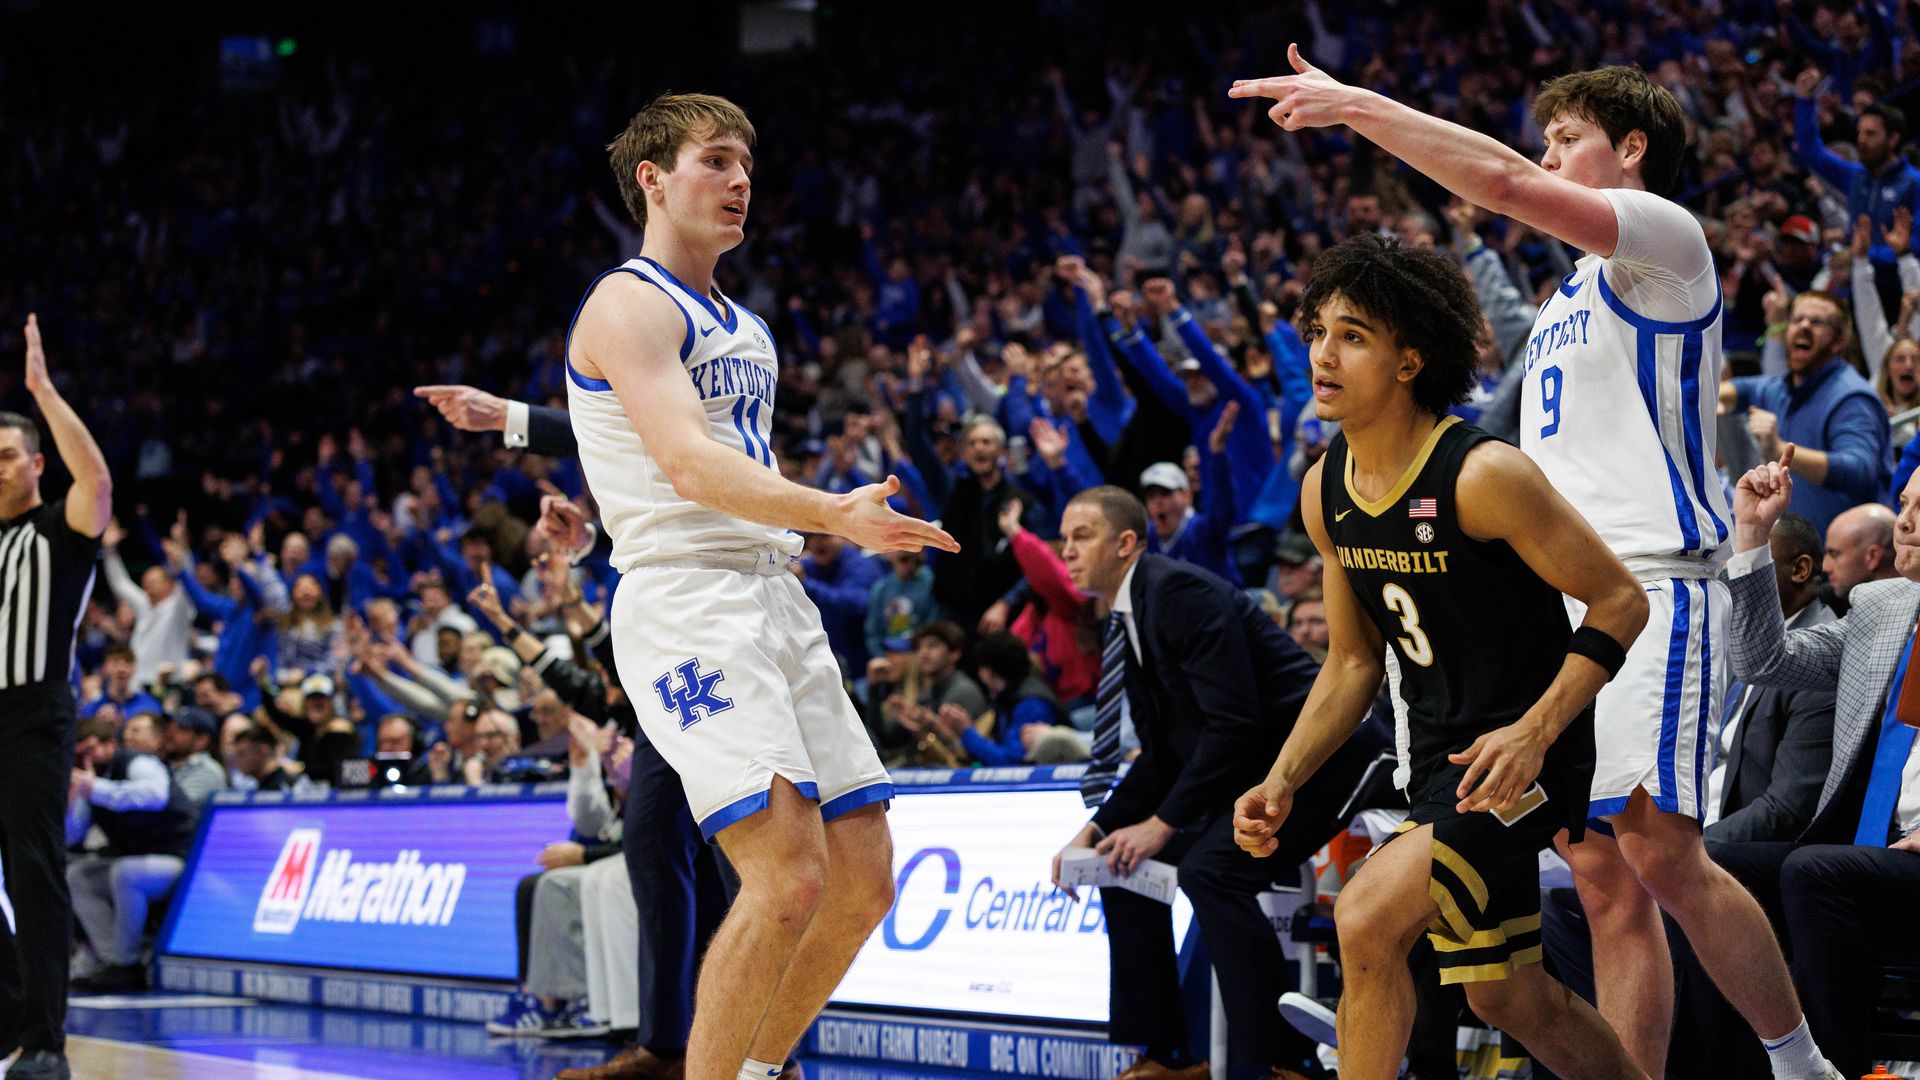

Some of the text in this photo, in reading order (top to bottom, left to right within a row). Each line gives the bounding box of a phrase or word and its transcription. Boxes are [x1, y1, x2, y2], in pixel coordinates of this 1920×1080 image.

[731, 395, 771, 469] 11
[1541, 365, 1563, 440] 9
[1336, 546, 1449, 573] VANDERBILT
[1417, 524, 1433, 542] SEC
[1382, 582, 1434, 668] 3
[652, 657, 734, 731] UK
[303, 849, 467, 926] Marathon
[965, 877, 1077, 933] Central
[818, 1020, 968, 1068] KENTUCKY FARM BUREAU
[990, 1034, 1014, 1072] BIG
[1017, 1037, 1039, 1075] ON
